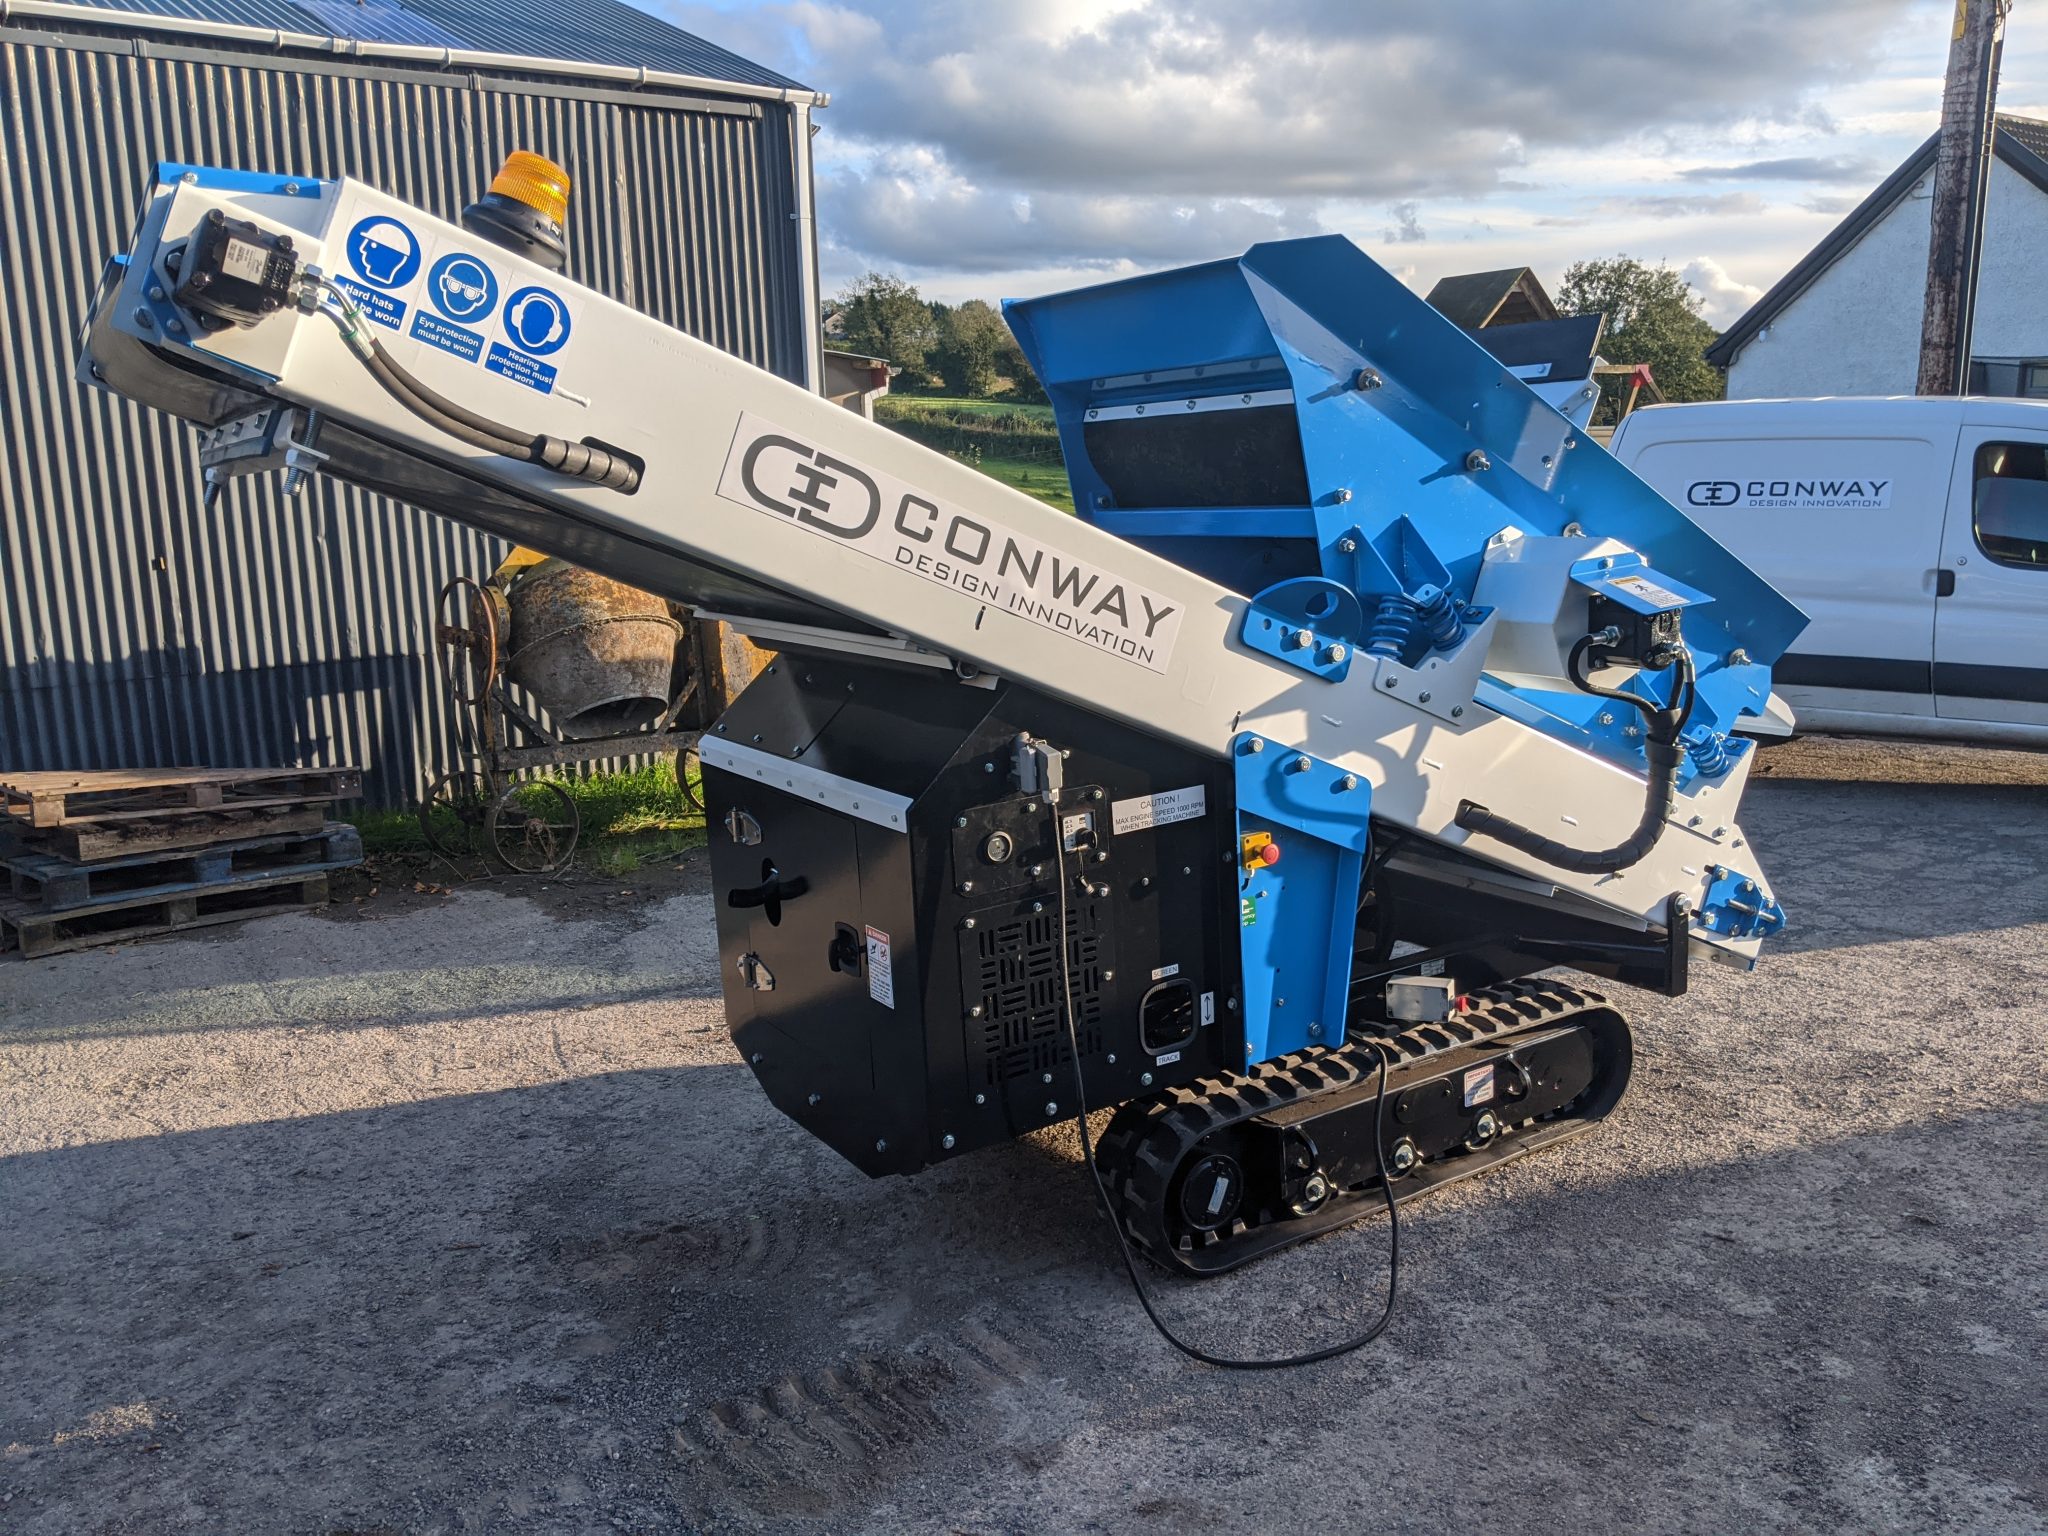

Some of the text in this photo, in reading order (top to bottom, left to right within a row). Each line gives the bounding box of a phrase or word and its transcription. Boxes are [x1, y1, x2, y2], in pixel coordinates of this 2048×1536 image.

[345, 283, 394, 311] Hard hats
[360, 301, 372, 314] be
[374, 309, 400, 326] worn
[417, 329, 474, 357] must be worn
[418, 316, 480, 348] Eye protection
[489, 353, 553, 385] protection must
[508, 350, 540, 371] Hearing
[502, 366, 535, 386] be worn
[1746, 481, 1889, 497] CONWAY
[1749, 499, 1882, 508] DESIGN INNOVATION
[894, 493, 1176, 639] CONWAY
[894, 545, 1155, 664] DESIGN INNOVATION
[1115, 801, 1204, 825] MAX ENGINE SPEED 1000 RPM
[1140, 796, 1176, 810] CAUTION
[1120, 809, 1200, 832] WHEN TRACKING MACHINE
[1153, 965, 1178, 978] SCREEN
[1158, 1053, 1180, 1065] TRACK
